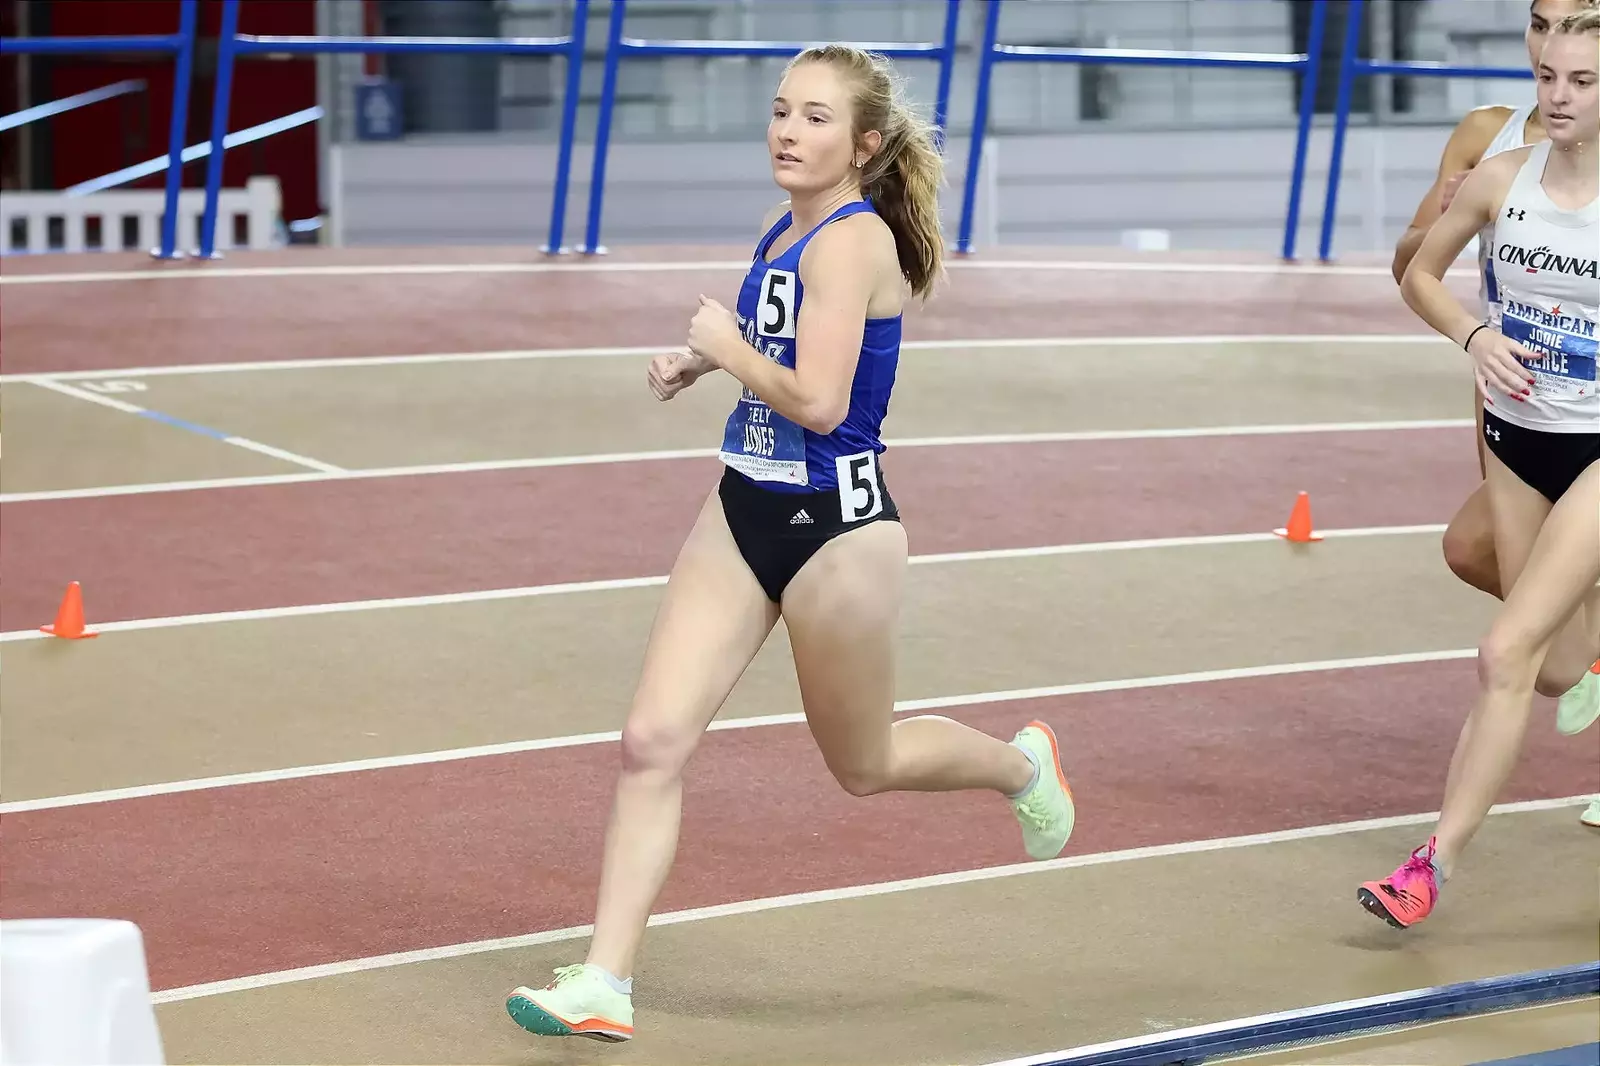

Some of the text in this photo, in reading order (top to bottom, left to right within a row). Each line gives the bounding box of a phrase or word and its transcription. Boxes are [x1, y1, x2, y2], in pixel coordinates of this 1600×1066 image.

[1498, 243, 1600, 280] CINCINNA
[763, 274, 787, 334] 5
[1506, 300, 1596, 338] AMERICAN
[1529, 327, 1565, 349] JODIE
[743, 423, 775, 457] JONES
[849, 456, 875, 518] 5
[789, 517, 815, 525] adidas
